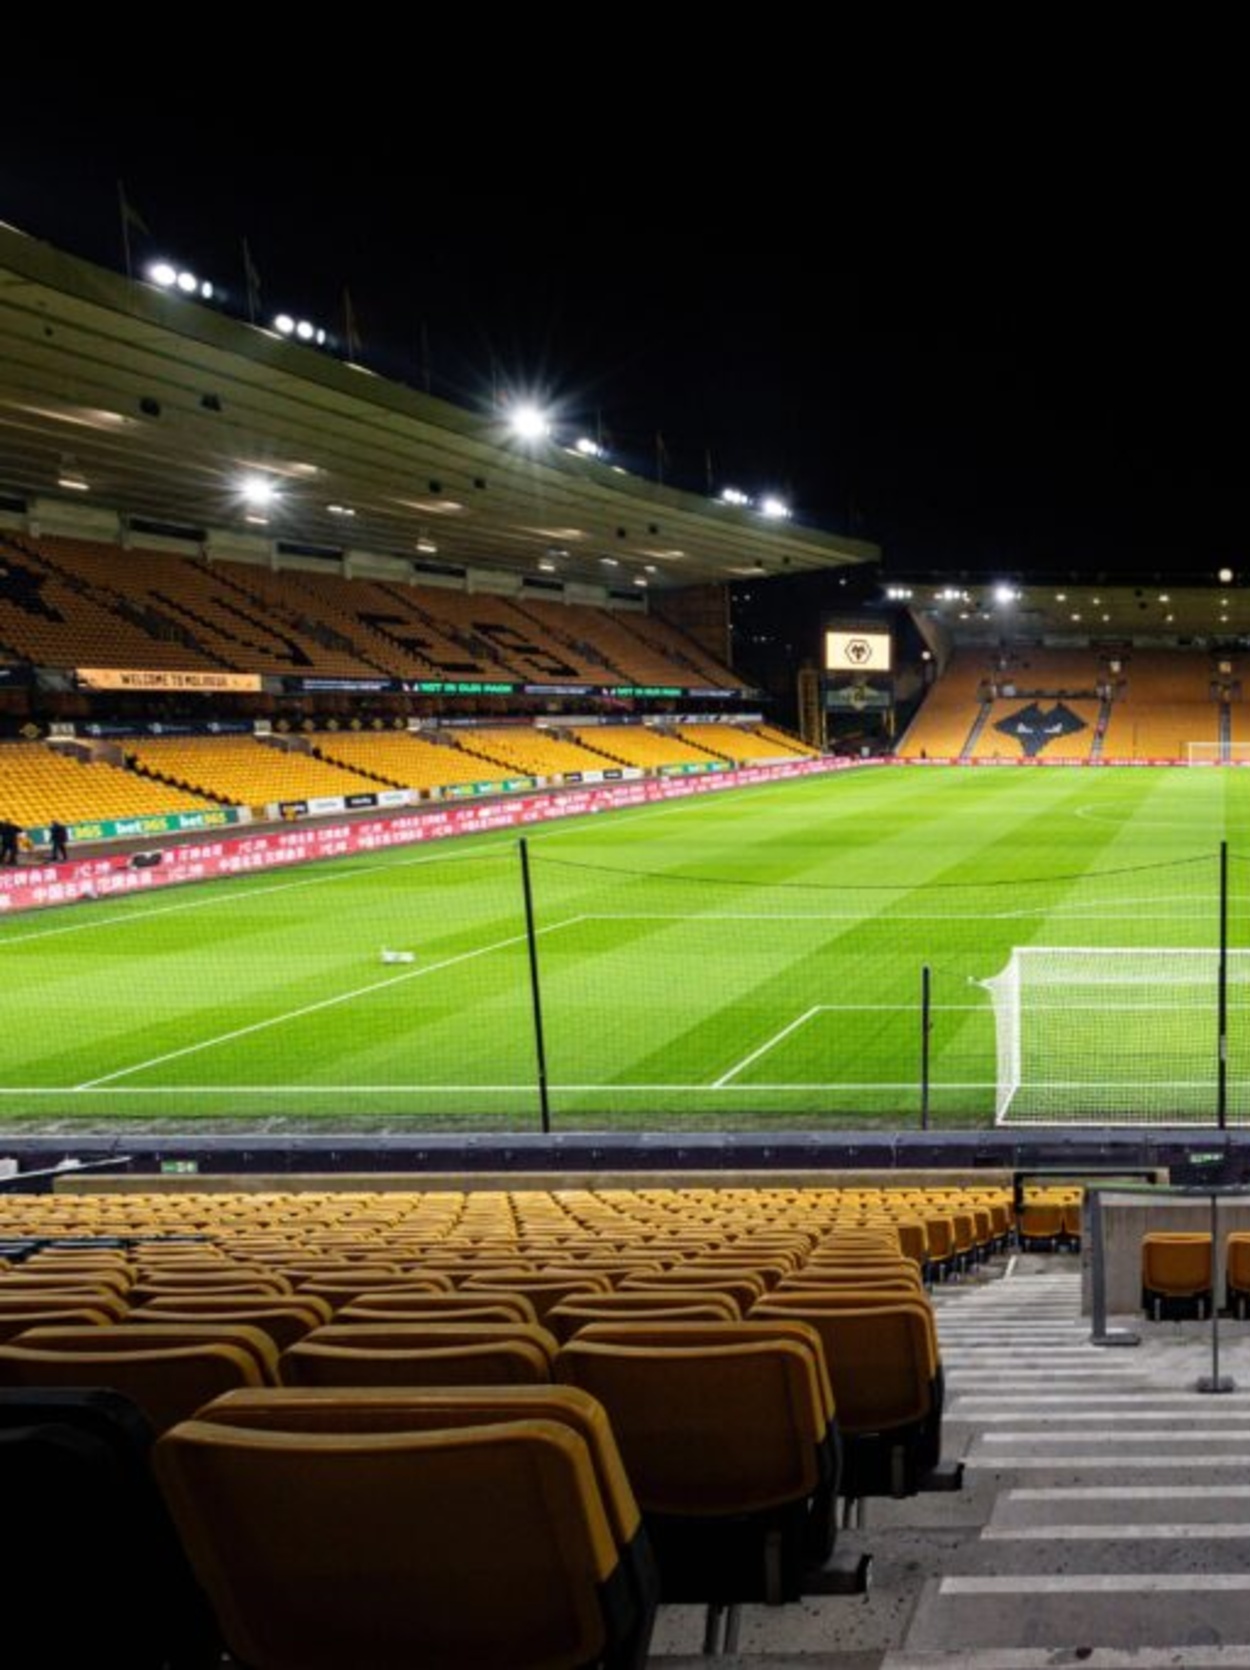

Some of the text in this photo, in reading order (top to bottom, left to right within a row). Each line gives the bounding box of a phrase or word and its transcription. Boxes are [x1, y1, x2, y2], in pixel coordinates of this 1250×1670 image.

[120, 673, 169, 687] WELCOME
[114, 817, 168, 836] bet365
[179, 811, 228, 829] bet365
